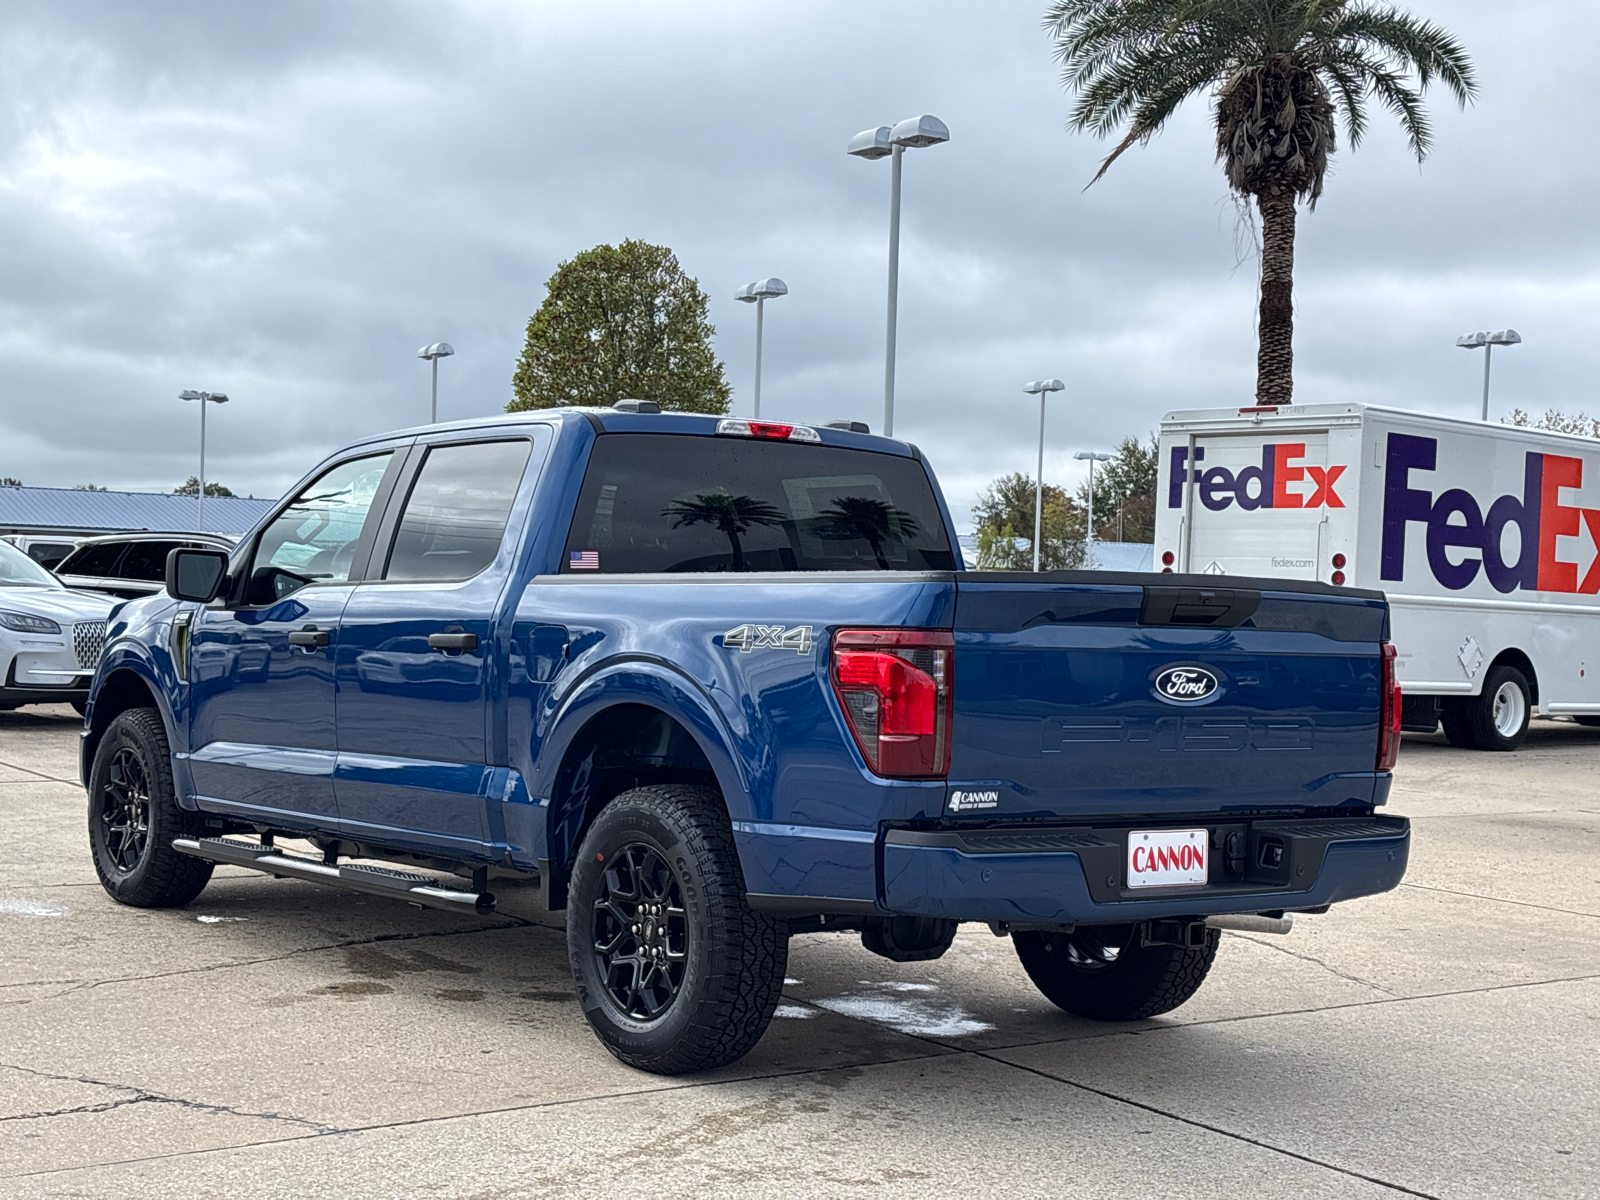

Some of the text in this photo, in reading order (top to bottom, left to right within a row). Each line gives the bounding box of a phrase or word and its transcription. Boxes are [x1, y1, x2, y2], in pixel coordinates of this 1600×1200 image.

[1168, 443, 1348, 511] FedEx
[1271, 557, 1314, 568] fedex.com
[1166, 670, 1207, 695] Ford
[961, 790, 999, 803] CANNON
[1132, 844, 1204, 873] CANNON
